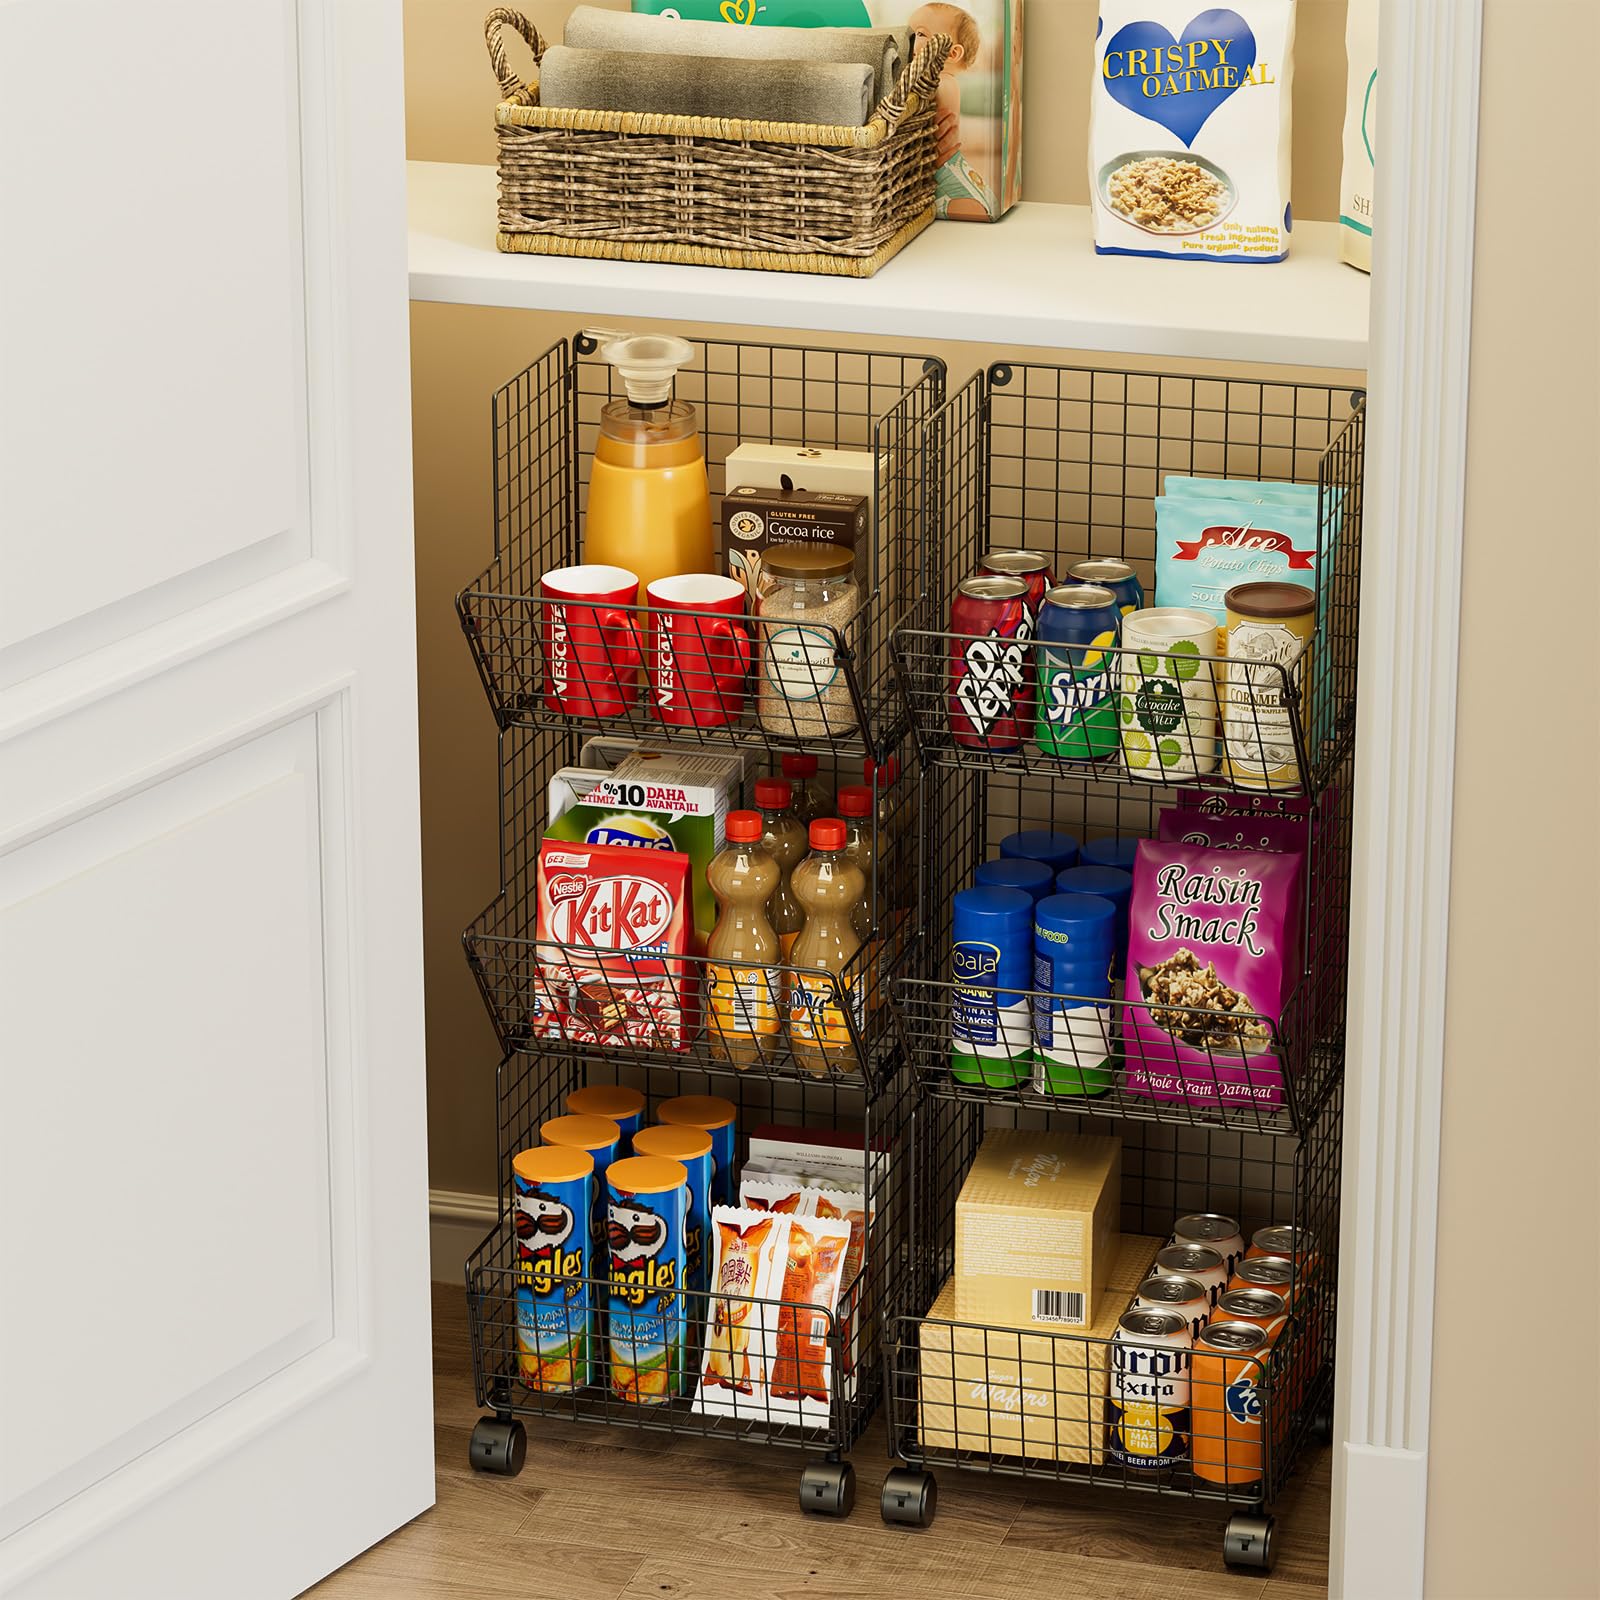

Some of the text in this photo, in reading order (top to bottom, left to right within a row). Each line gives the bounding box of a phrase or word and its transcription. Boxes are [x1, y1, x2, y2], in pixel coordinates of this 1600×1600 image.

[1103, 38, 1233, 80] CRISPY
[1142, 63, 1275, 99] OATMEAL
[1182, 241, 1278, 253] Pure organic product
[1200, 232, 1279, 244] Fresh ingredients
[770, 511, 797, 519] GLUTEN
[769, 521, 836, 540] Cocoa rice
[1206, 520, 1286, 553] Ace
[1200, 554, 1285, 576] Potato Chips
[604, 784, 645, 812] %10
[647, 787, 687, 803] DAHA
[646, 800, 699, 813] AVANTAJLI
[1158, 864, 1263, 907] Raisin
[567, 880, 663, 951] KitKat
[1148, 903, 1265, 957] Smack
[1133, 1070, 1275, 1099] Whole Grain Oatmeal
[967, 1377, 1050, 1412] Wafers
[1115, 1374, 1175, 1398] Extra
[1127, 1456, 1147, 1467] BEER
[1147, 1459, 1171, 1467] FROM
